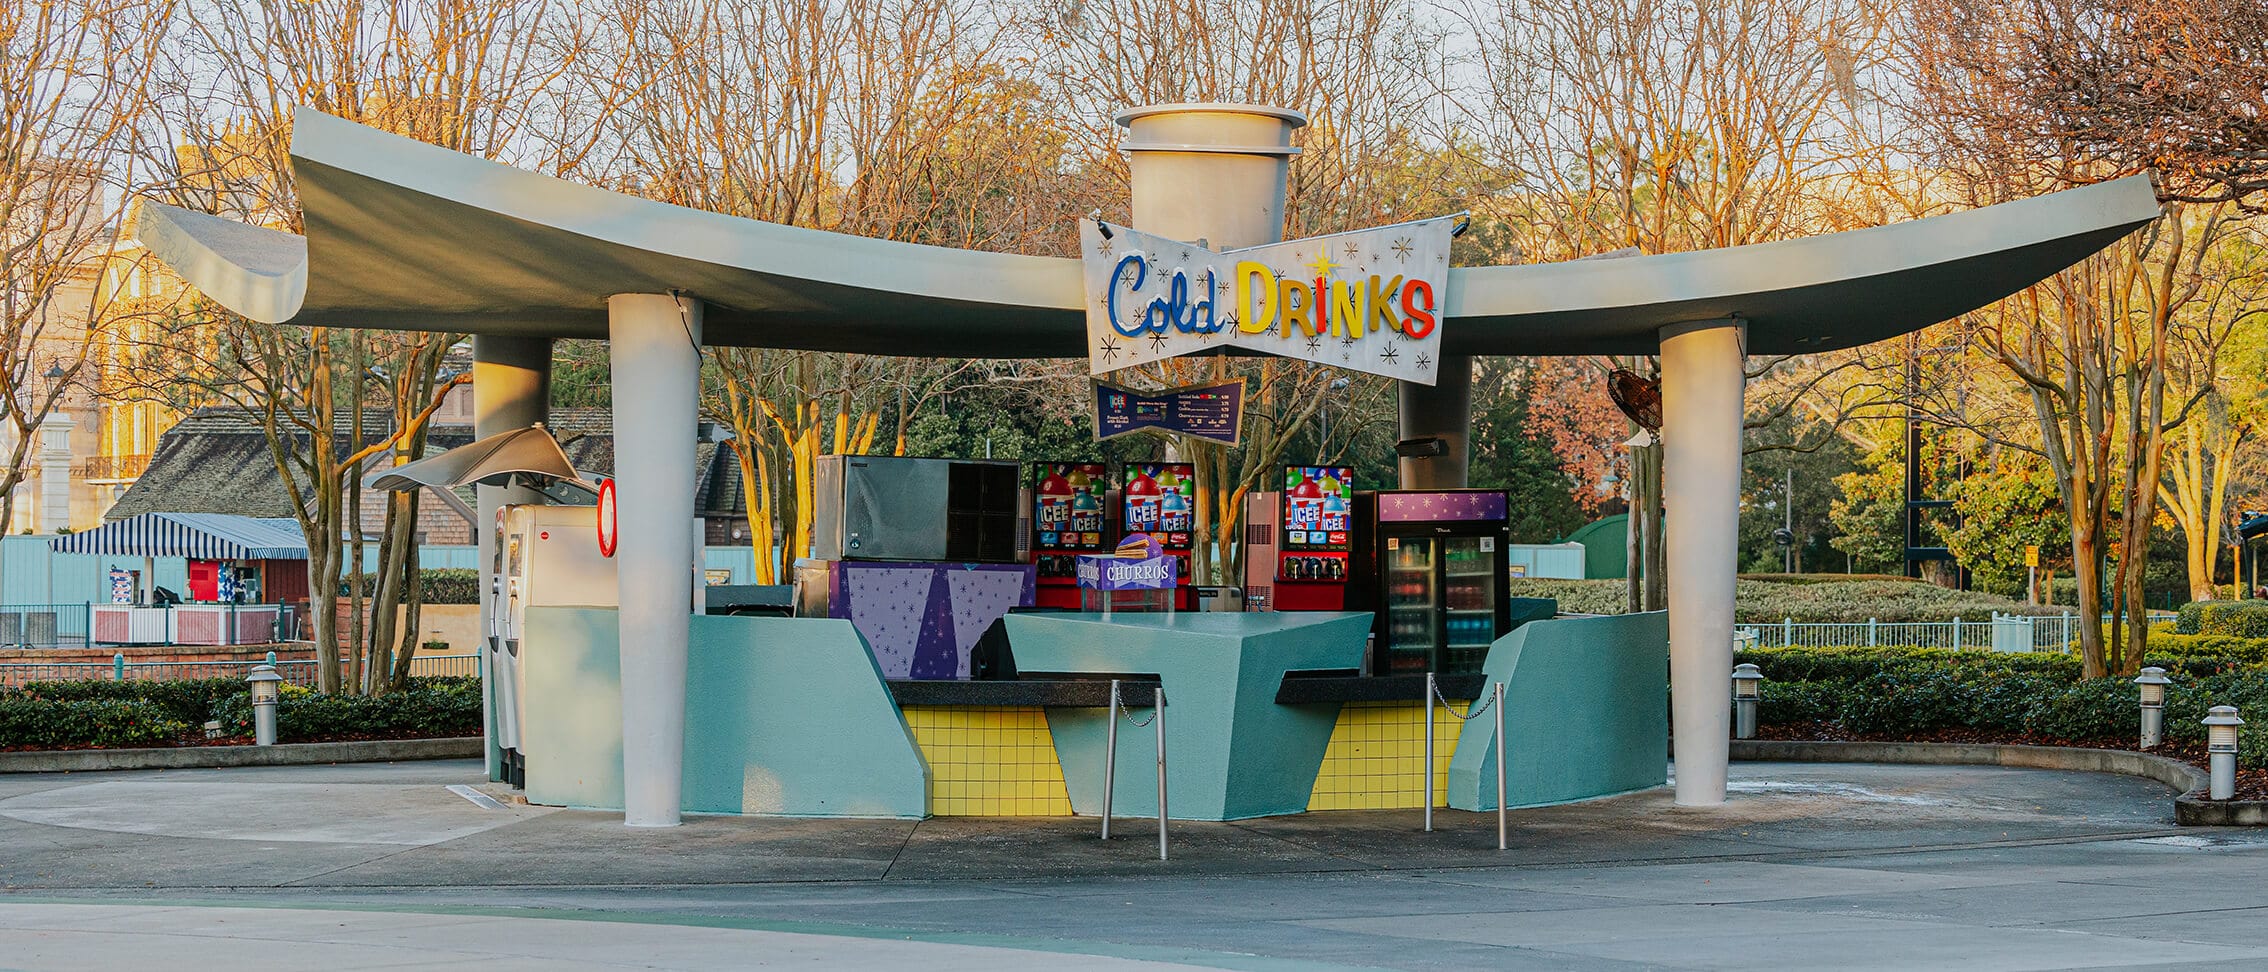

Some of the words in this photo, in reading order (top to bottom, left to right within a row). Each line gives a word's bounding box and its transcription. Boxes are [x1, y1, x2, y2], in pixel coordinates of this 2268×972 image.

[1107, 249, 1225, 337] Cold
[1040, 505, 1069, 522] ICEE
[1129, 505, 1158, 523] ICEE
[1293, 506, 1321, 524] ICEE
[1074, 517, 1097, 531] ICEE
[1162, 517, 1185, 531] ICEE
[1322, 517, 1344, 531] ICEE
[1106, 565, 1169, 581] CHURROS
